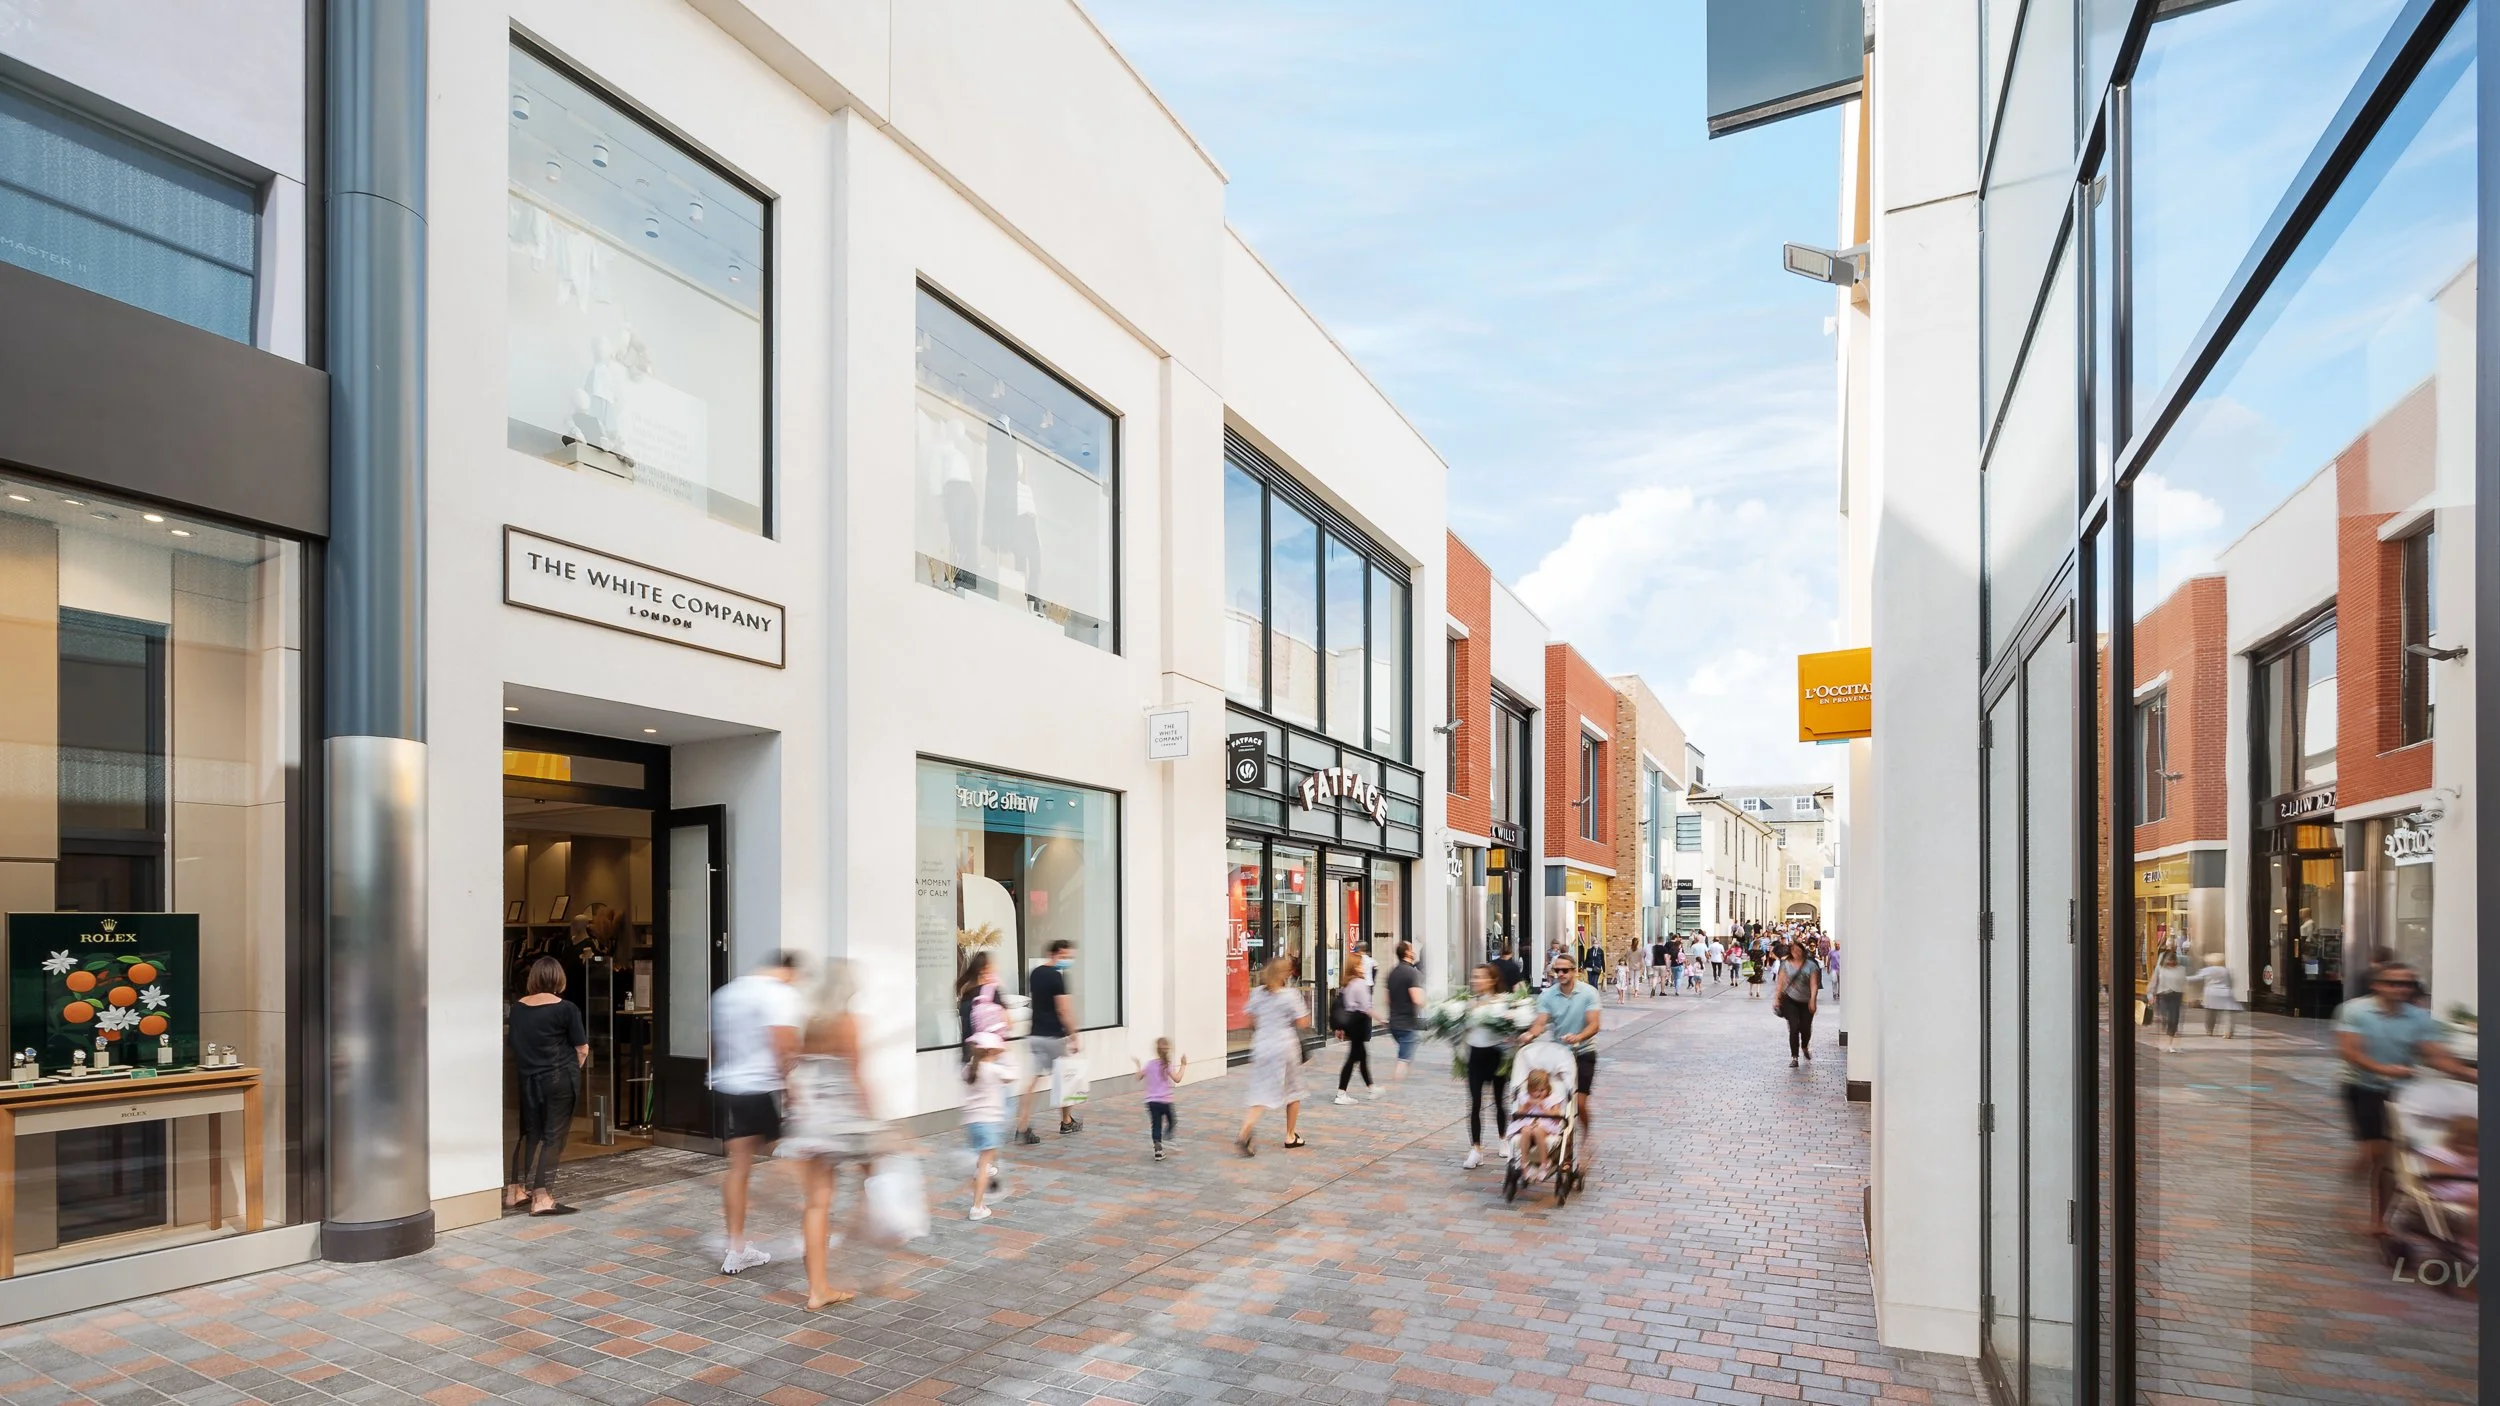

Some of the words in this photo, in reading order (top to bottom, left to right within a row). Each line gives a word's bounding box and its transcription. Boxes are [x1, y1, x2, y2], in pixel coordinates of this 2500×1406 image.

[527, 552, 576, 580] THE
[587, 568, 663, 604] WHITE
[671, 593, 772, 632] COMPANY
[629, 605, 692, 629] LONDON
[1230, 736, 1263, 748] FATFACE
[1299, 767, 1389, 827] FATFACE
[1498, 826, 1515, 842] WILLS
[921, 878, 951, 887] MOMENT
[917, 889, 928, 897] OF
[929, 889, 948, 897] CALM
[80, 933, 138, 943] ROLEX
[121, 1110, 147, 1118] ROLEX
[2391, 1256, 2479, 1288] LOV
